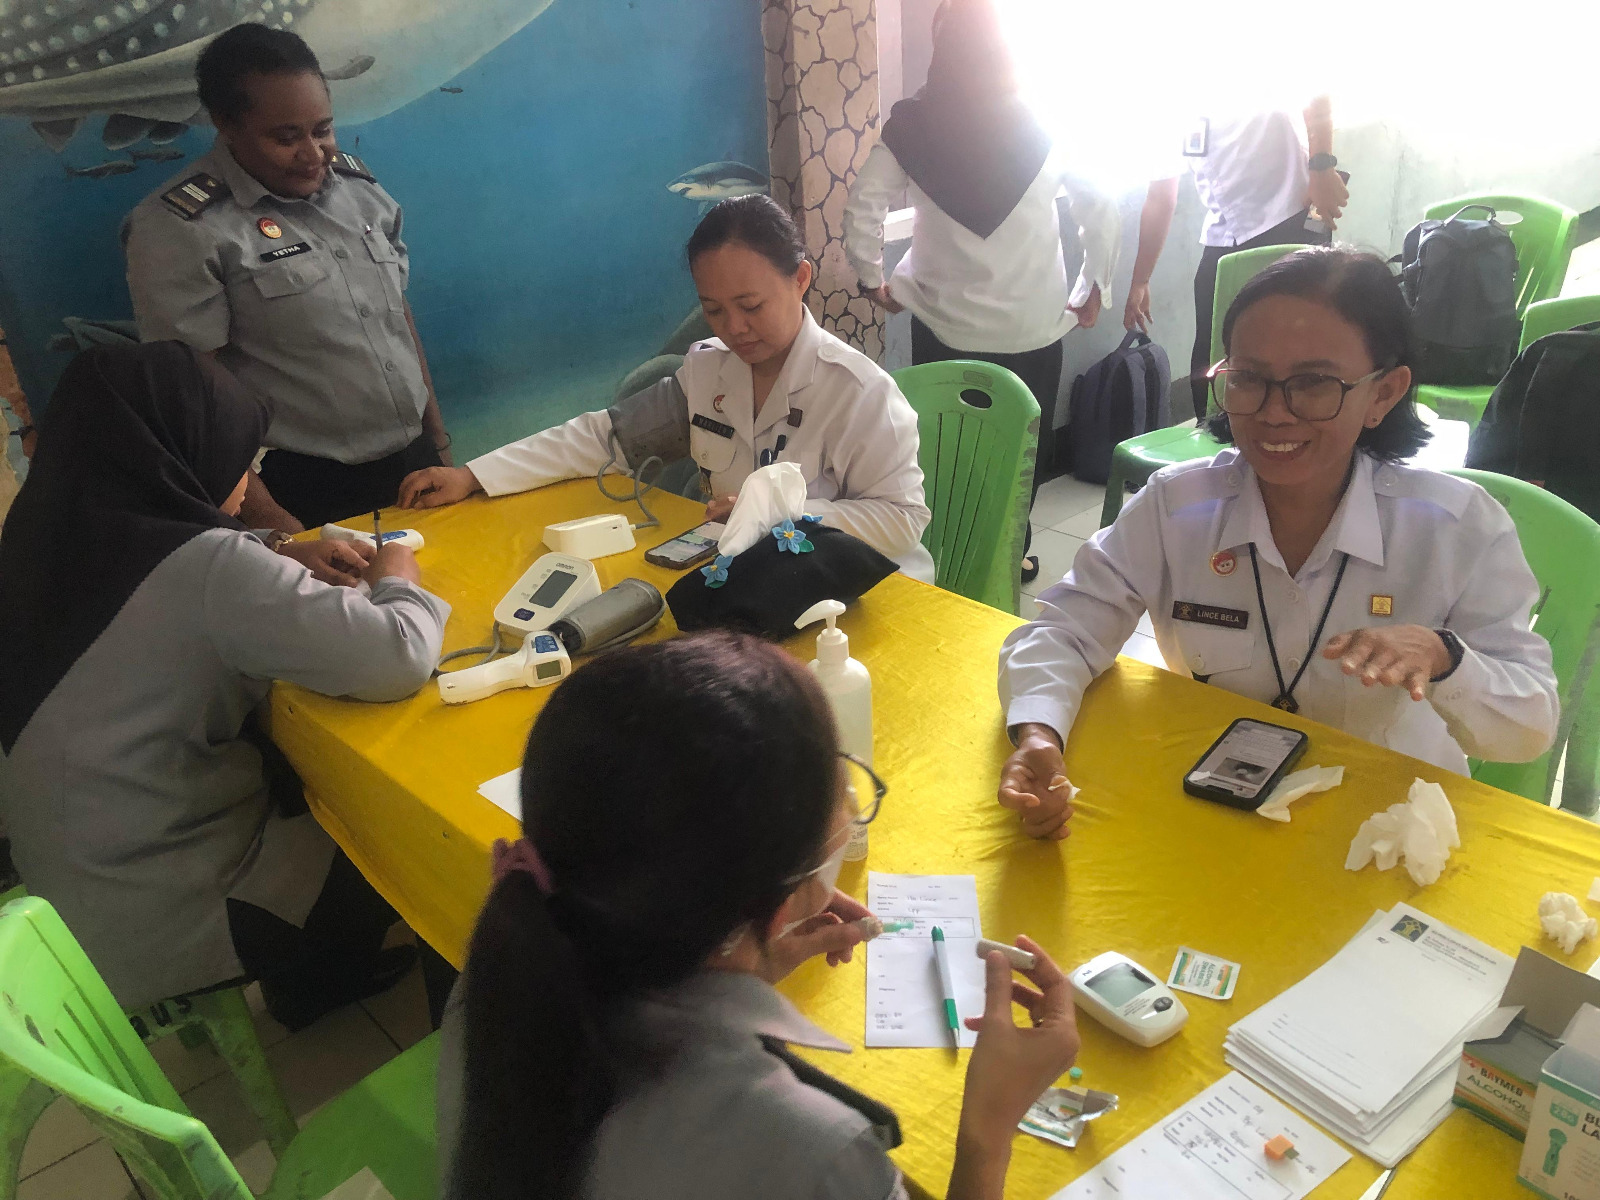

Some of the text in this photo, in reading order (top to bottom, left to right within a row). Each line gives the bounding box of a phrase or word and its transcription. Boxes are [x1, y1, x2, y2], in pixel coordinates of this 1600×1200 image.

[1197, 609, 1240, 622] LINCE BELA
[1467, 1074, 1531, 1115] ALCOHOL
